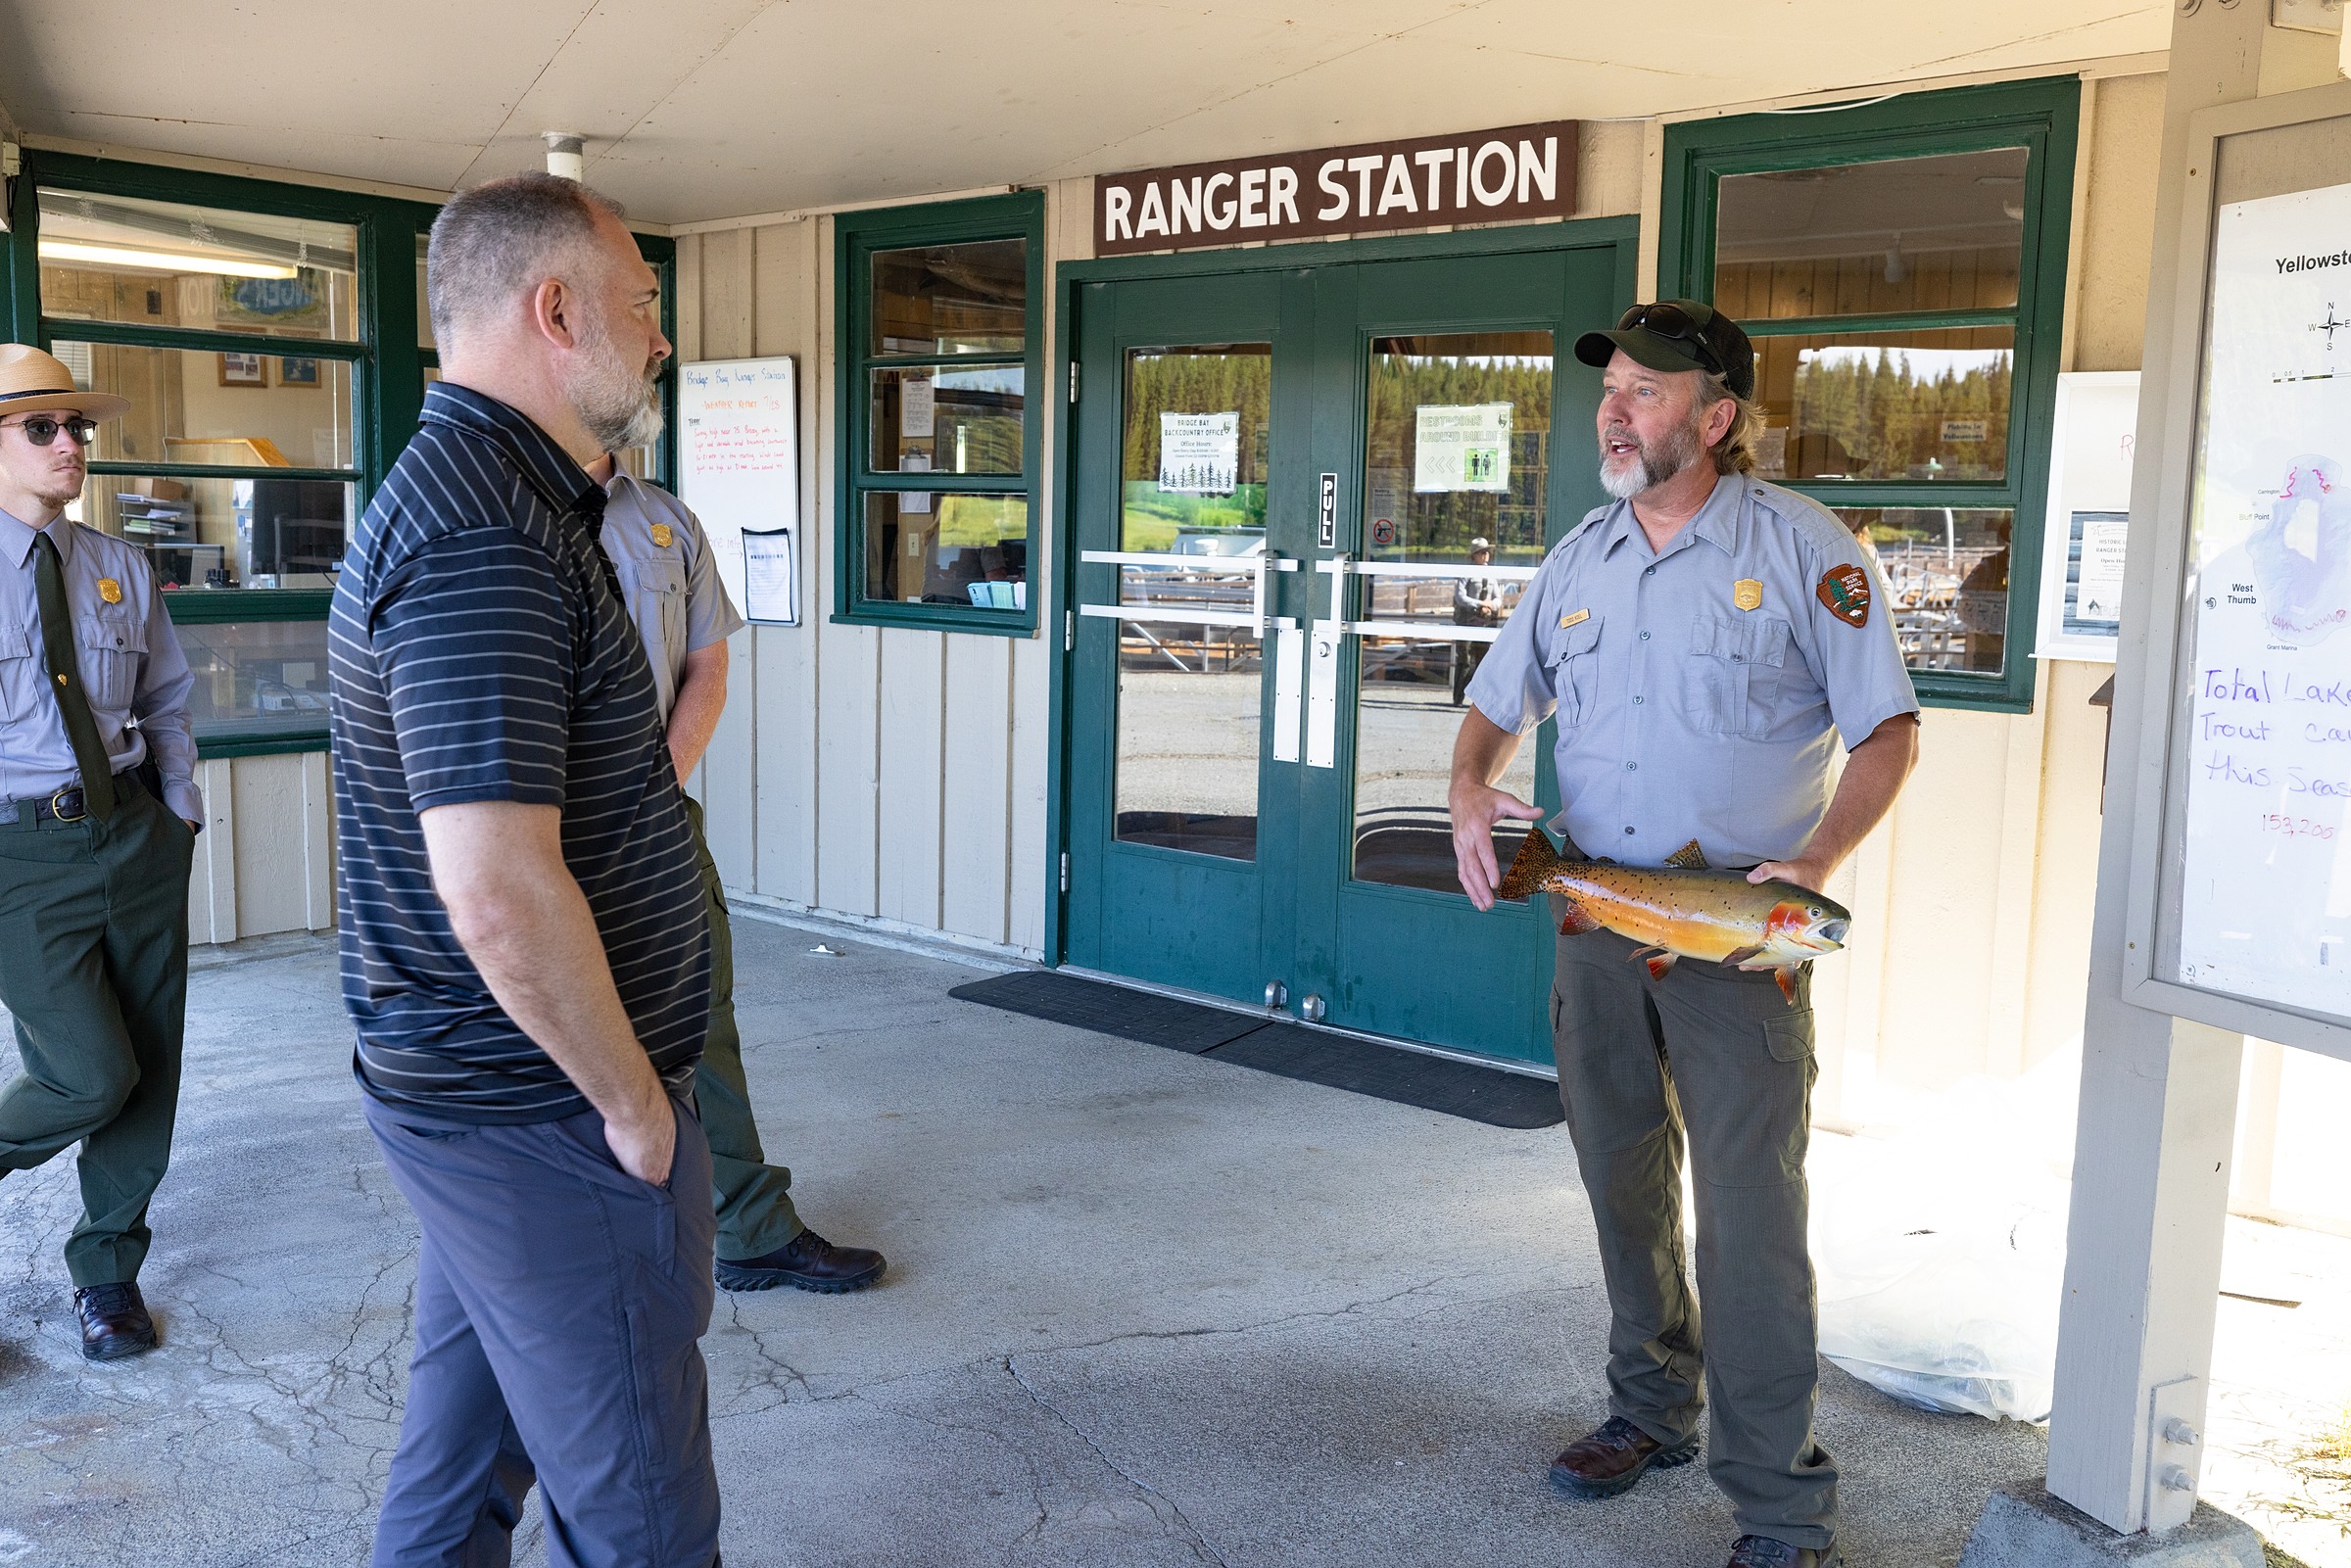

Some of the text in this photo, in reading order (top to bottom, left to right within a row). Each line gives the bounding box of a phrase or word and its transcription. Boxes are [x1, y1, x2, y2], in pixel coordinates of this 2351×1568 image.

[1105, 136, 1558, 241] RANGER STATION
[2276, 249, 2351, 274] Yellowst
[2308, 319, 2351, 332] W E
[2327, 343, 2333, 352] S
[1419, 414, 1483, 428] RESTROOMS
[1419, 431, 1460, 443] AROUND
[1321, 480, 1334, 541] PULL
[1841, 571, 1861, 583] NATIONAL
[1846, 580, 1863, 592] SERVICE
[2231, 583, 2253, 593] West
[2227, 594, 2257, 604] Thumb
[2205, 668, 2271, 703] Total
[2200, 712, 2271, 740] Trout
[2205, 749, 2271, 786] this
